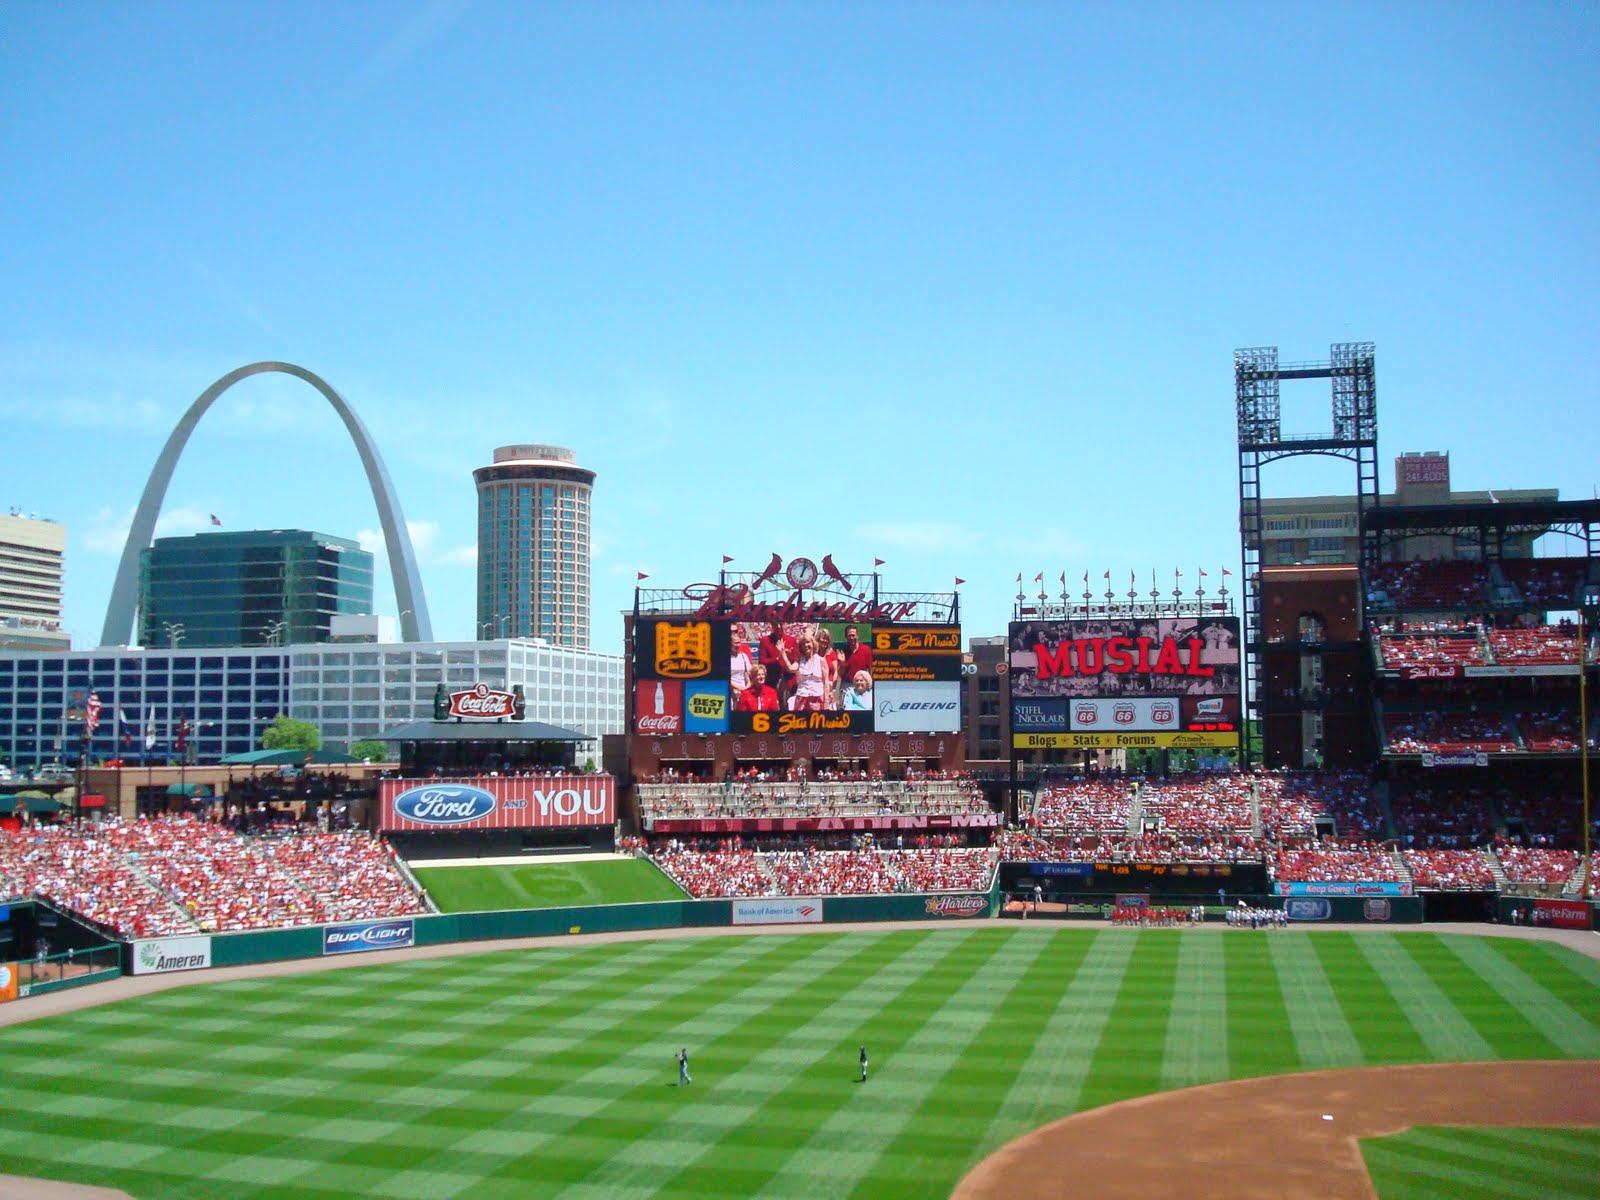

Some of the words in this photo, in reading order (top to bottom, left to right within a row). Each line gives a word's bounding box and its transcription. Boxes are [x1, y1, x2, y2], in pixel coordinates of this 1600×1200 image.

[682, 582, 916, 622] Budweiser
[1034, 603, 1099, 617] WORLD
[1104, 602, 1214, 616] CHAMPIONS
[876, 633, 891, 649] 6
[1033, 636, 1215, 680] MUSIAL
[693, 697, 725, 708] BEST
[899, 702, 957, 710] BOEING
[694, 706, 722, 715] BUY
[1015, 705, 1044, 715] STIFEL
[1116, 711, 1132, 721] 66
[1154, 711, 1170, 720] 66
[1019, 713, 1065, 724] NICOLAUS
[1079, 712, 1094, 721] 66
[752, 714, 770, 732] 6
[681, 741, 687, 753] 1
[706, 741, 715, 754] 2
[732, 741, 742, 754] 6
[758, 740, 768, 754] 9
[783, 740, 796, 754] 14
[808, 740, 821, 754] 17
[833, 740, 849, 753] 20
[858, 740, 874, 753] 42
[883, 740, 900, 753] 45
[908, 739, 925, 753] 85
[1028, 735, 1057, 747] Blogs
[1073, 735, 1100, 745] Stats
[1116, 735, 1156, 745] Forums
[413, 789, 477, 818] Ford
[503, 799, 528, 809] AND
[534, 789, 606, 816] YOU
[1327, 884, 1351, 895] Going
[738, 908, 755, 916] Bank
[756, 908, 764, 916] of
[764, 907, 794, 916] America
[1291, 901, 1325, 916] FSN
[326, 932, 360, 944] BUD
[367, 926, 411, 940] LIGHT
[156, 954, 205, 970] Ameren
